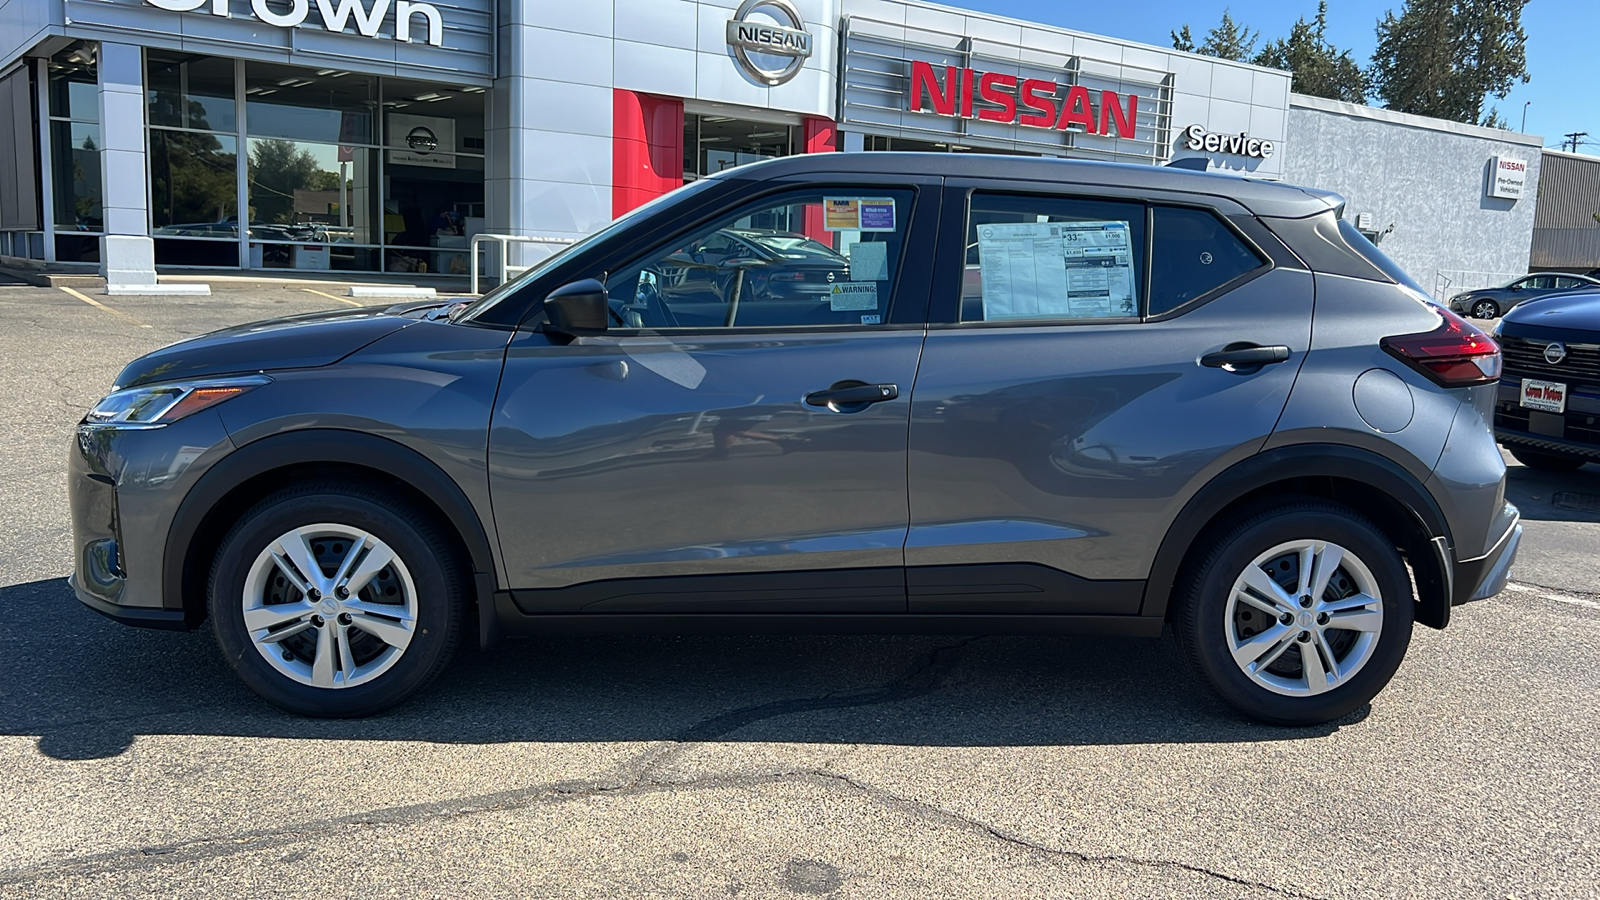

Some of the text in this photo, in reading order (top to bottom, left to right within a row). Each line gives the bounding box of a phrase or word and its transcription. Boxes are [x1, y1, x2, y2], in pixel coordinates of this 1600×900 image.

[144, 0, 443, 47] own
[738, 26, 807, 50] NISSAN
[910, 60, 1138, 139] NISSAN
[1186, 124, 1275, 159] Service
[1499, 160, 1525, 172] NISSAN
[1497, 177, 1523, 186] Pre-Owned
[1500, 186, 1519, 194] Vehicles
[1067, 233, 1078, 241] 33
